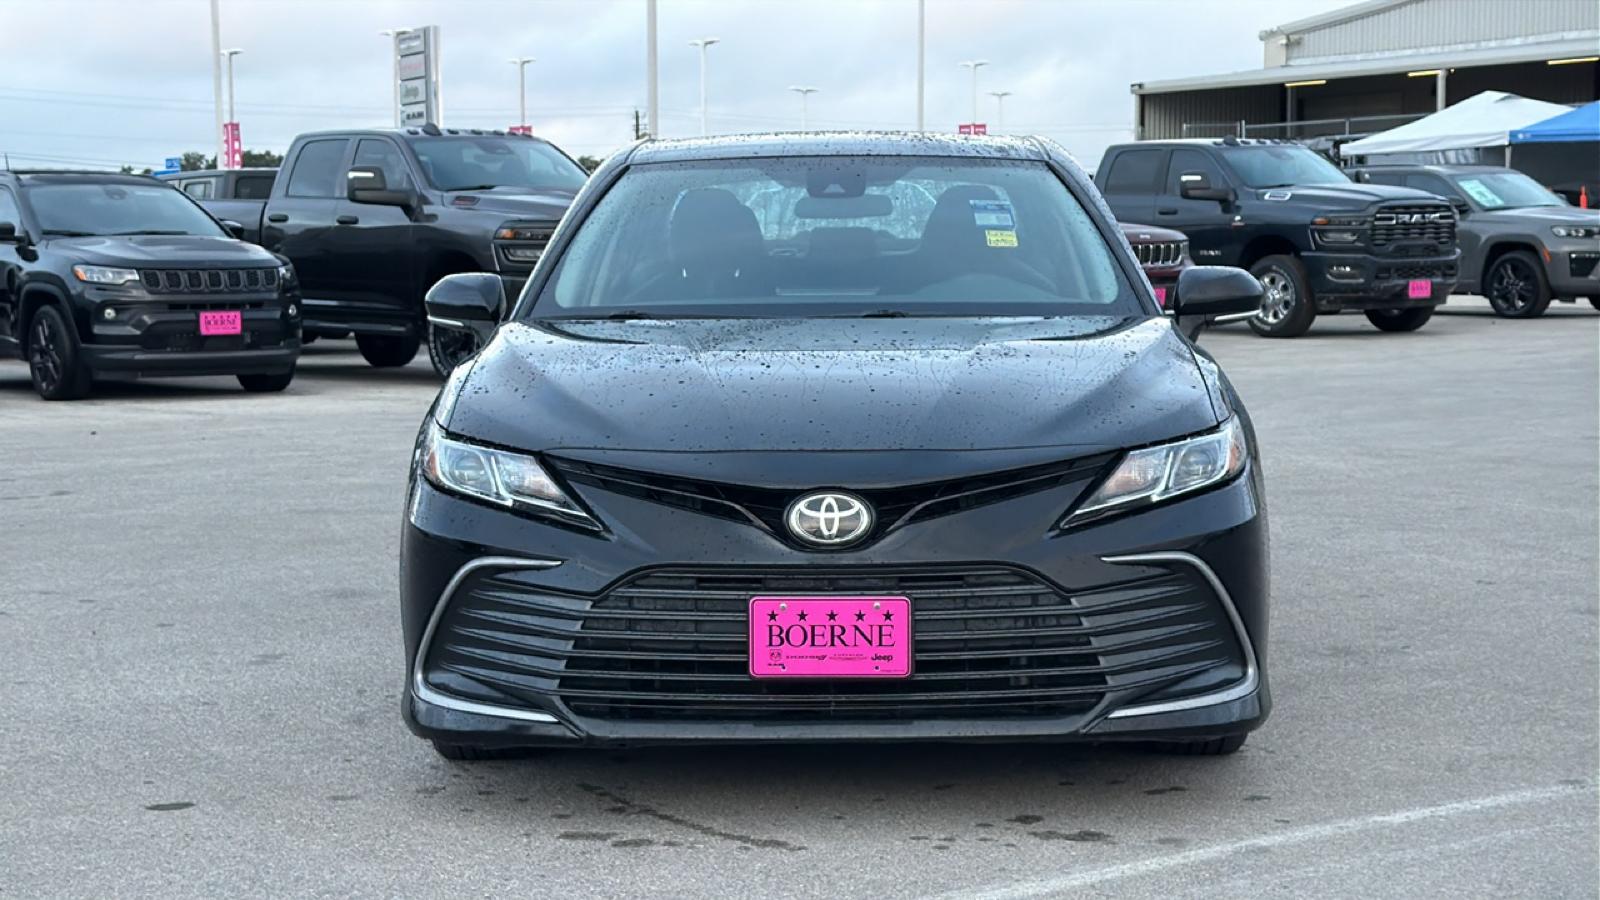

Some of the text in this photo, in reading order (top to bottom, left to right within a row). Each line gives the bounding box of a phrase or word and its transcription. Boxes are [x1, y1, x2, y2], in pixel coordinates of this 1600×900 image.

[405, 110, 425, 121] RAM
[766, 624, 896, 648] BOERNE
[870, 653, 893, 663] Jeep
